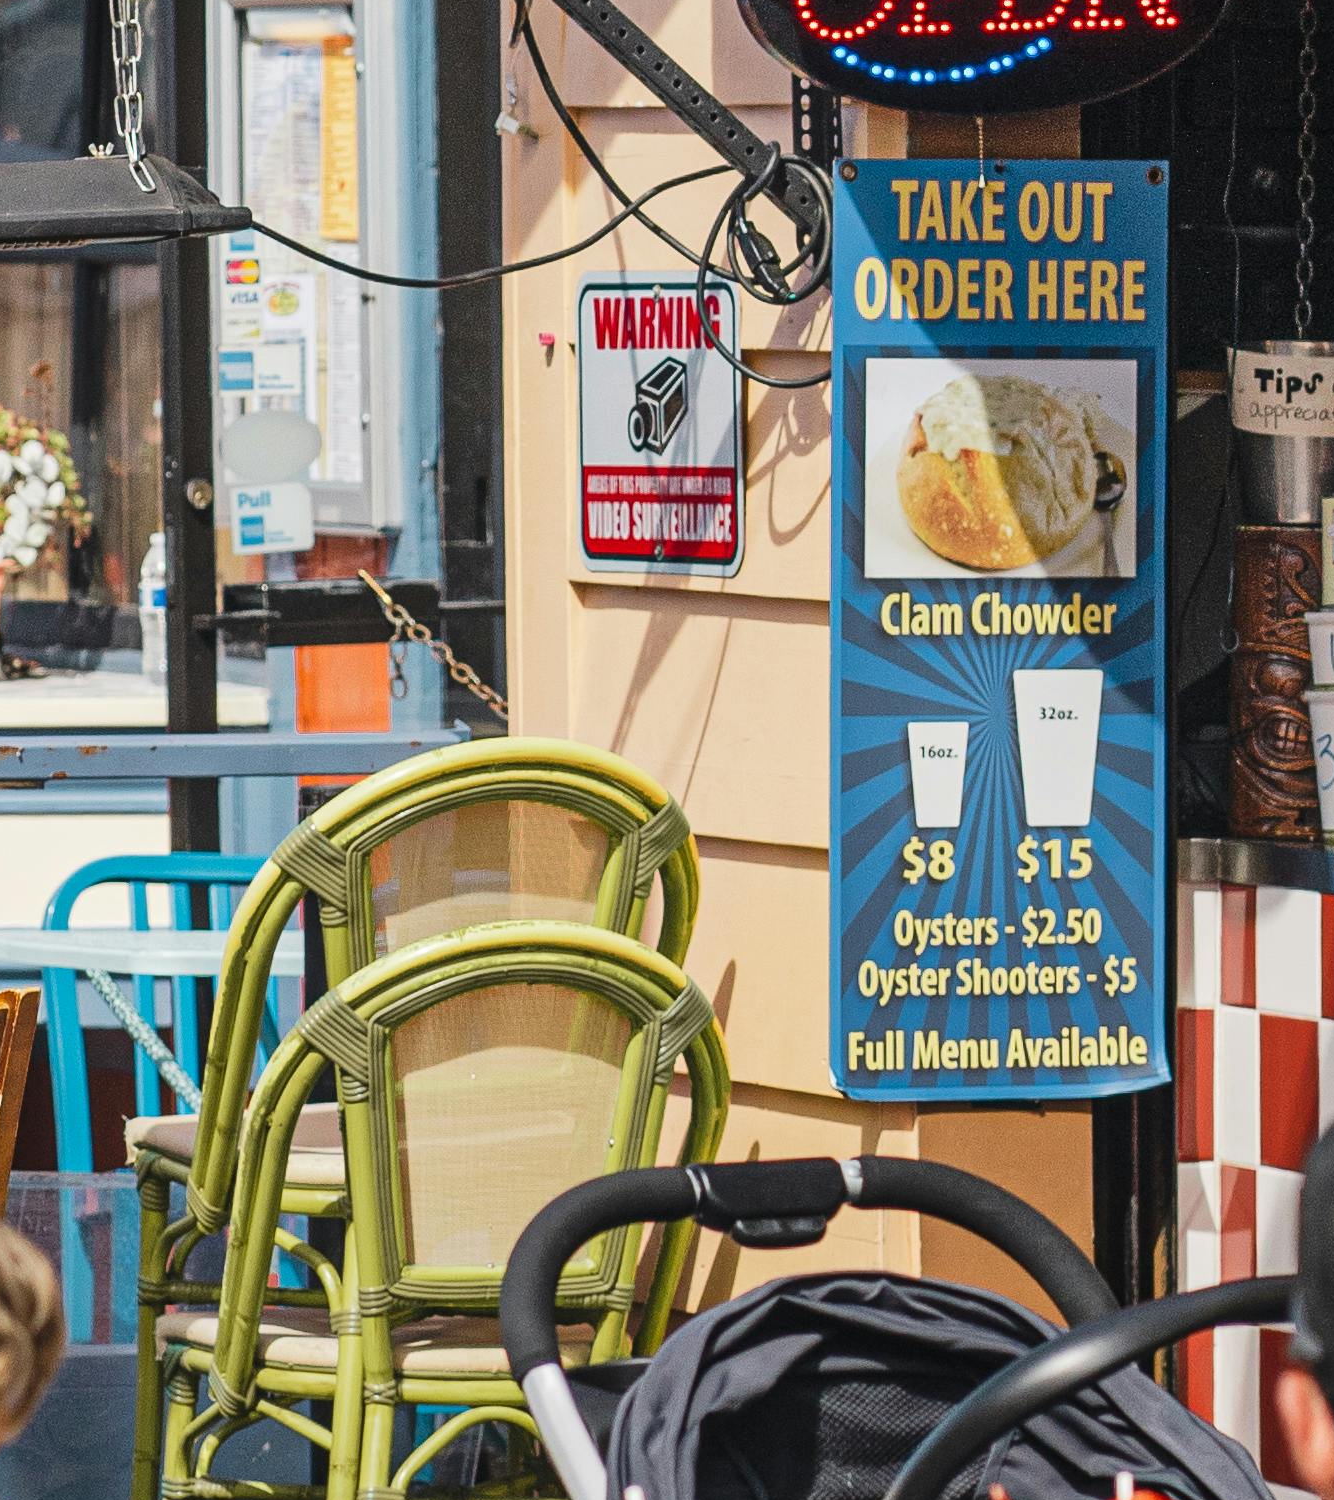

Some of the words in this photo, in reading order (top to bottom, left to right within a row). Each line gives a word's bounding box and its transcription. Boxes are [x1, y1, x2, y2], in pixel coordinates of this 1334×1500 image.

[890, 178, 1006, 242] TAKE
[1018, 180, 1114, 243] OUT
[854, 256, 1014, 321] ORDER
[1027, 259, 1147, 322] HERE
[593, 294, 722, 350] WARNING
[1254, 368, 1324, 404] Tips
[238, 490, 271, 508] Pull
[587, 501, 630, 540] VIDEO
[632, 501, 733, 543] SURVEILLANCE
[880, 592, 964, 637] Clam
[971, 592, 1117, 636] Chowder
[1038, 706, 1079, 721] 32oz.
[920, 745, 958, 759] 16oz.
[902, 835, 956, 884] $8
[1017, 834, 1093, 884] $15
[894, 909, 999, 956] Oysters
[1021, 905, 1103, 948] $2.50
[858, 960, 952, 1007] Oyster
[956, 957, 1081, 997] Shooters
[1104, 953, 1138, 998] $5
[848, 1029, 905, 1071] Full
[912, 1030, 999, 1070] Menu
[1005, 1025, 1148, 1069] Available
